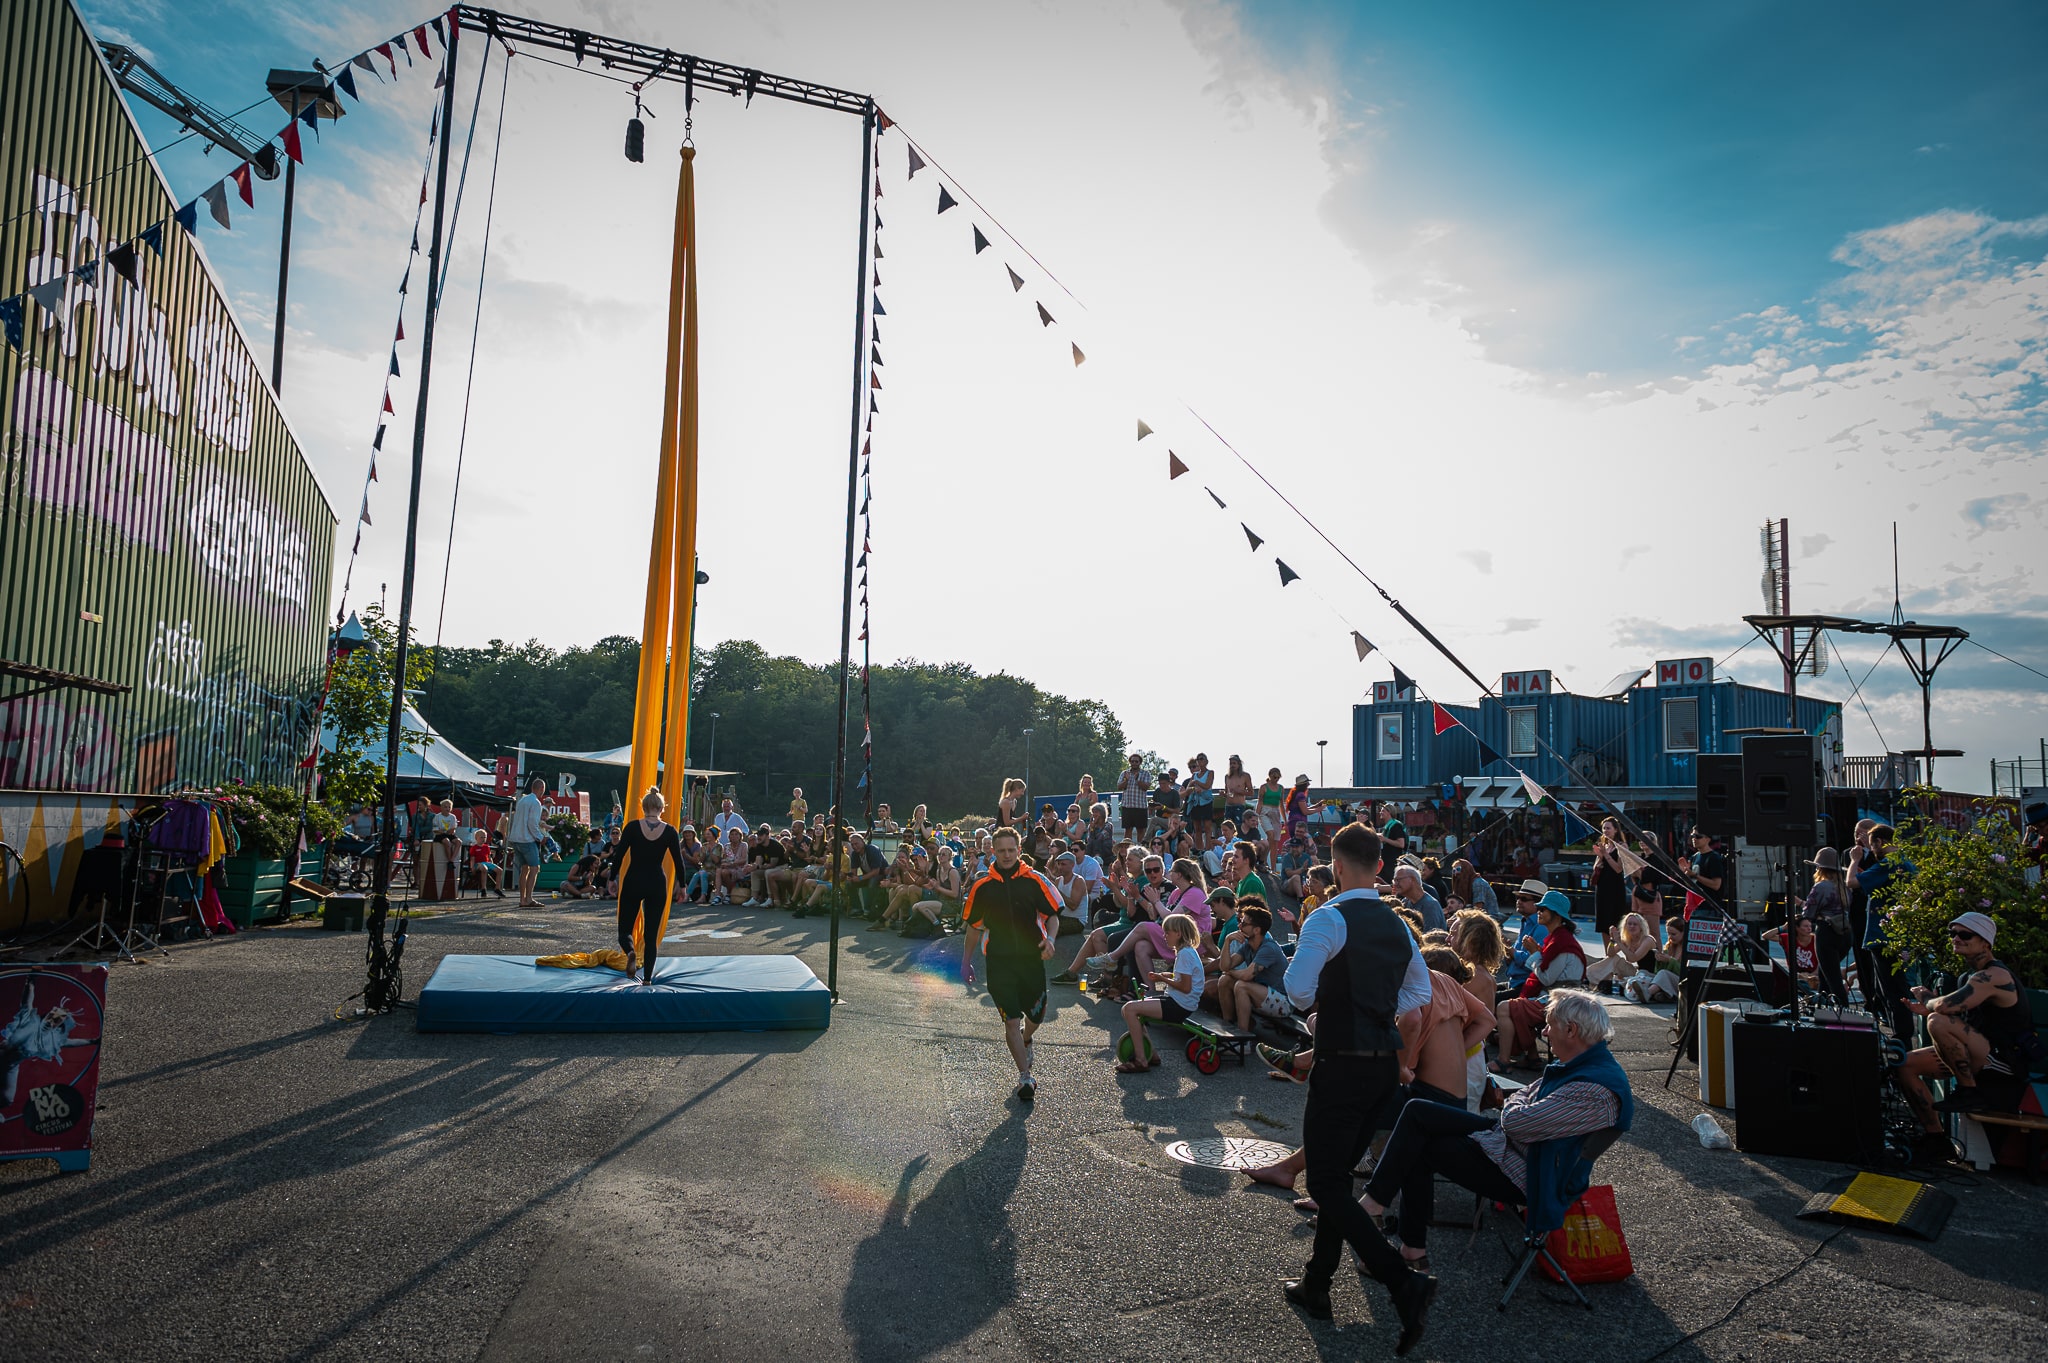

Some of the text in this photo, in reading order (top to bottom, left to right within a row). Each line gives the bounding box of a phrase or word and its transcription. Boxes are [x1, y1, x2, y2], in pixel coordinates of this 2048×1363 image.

[1507, 675, 1543, 692] NA
[1661, 662, 1703, 682] MO
[1691, 921, 1708, 930] IT'S
[1689, 932, 1717, 943] UNDER
[1688, 943, 1715, 954] SNOW
[34, 1093, 65, 1112] NA
[38, 1103, 71, 1122] MO
[35, 1119, 62, 1132] CIRCUS
[42, 1120, 74, 1136] FESTIVAL
